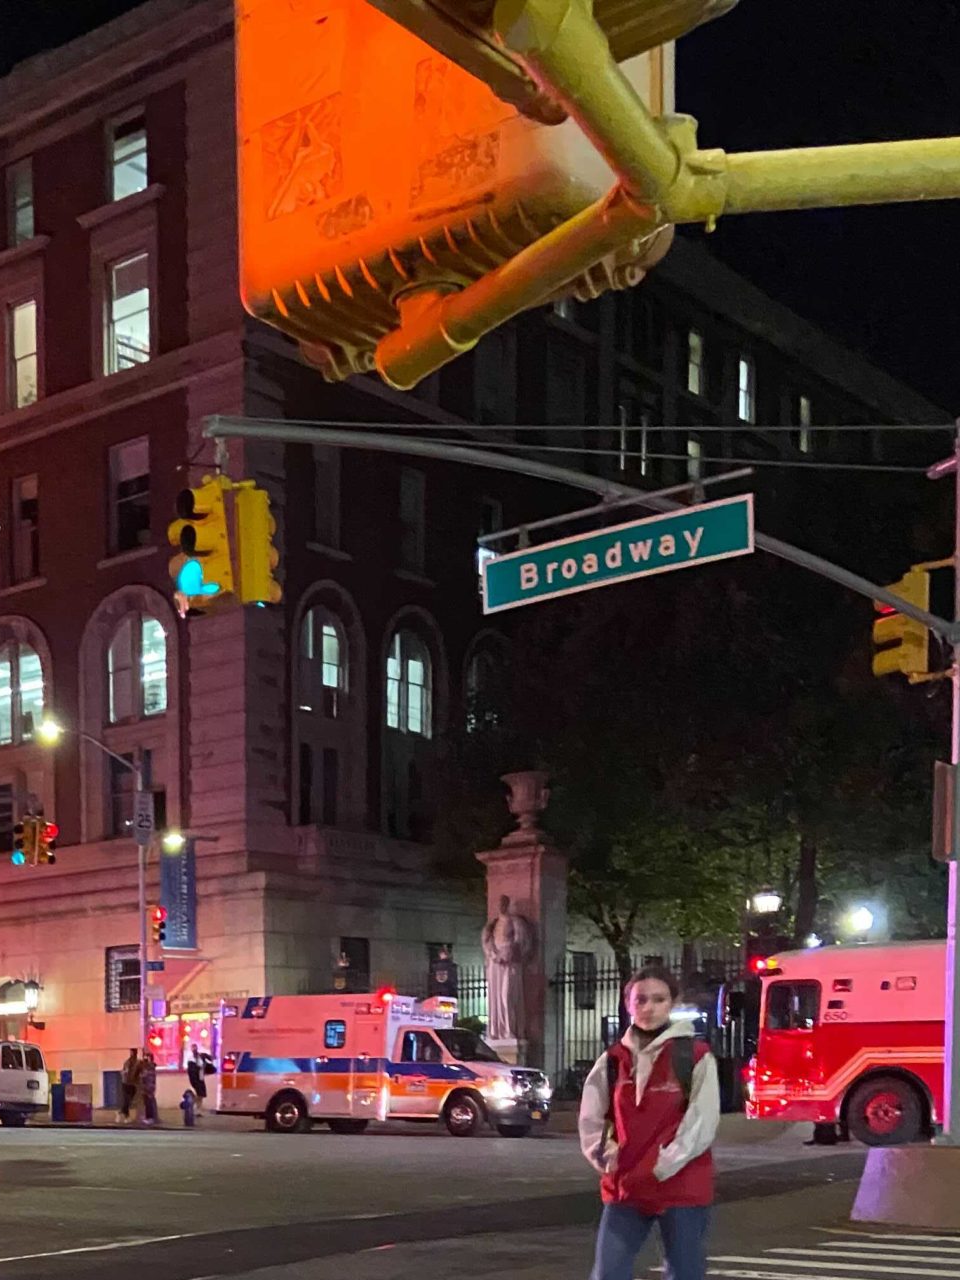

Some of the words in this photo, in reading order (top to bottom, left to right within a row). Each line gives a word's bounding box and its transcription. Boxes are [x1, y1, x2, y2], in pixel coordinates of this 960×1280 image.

[520, 527, 704, 590] Broadway
[138, 814, 151, 828] 25
[824, 1011, 849, 1021] 650
